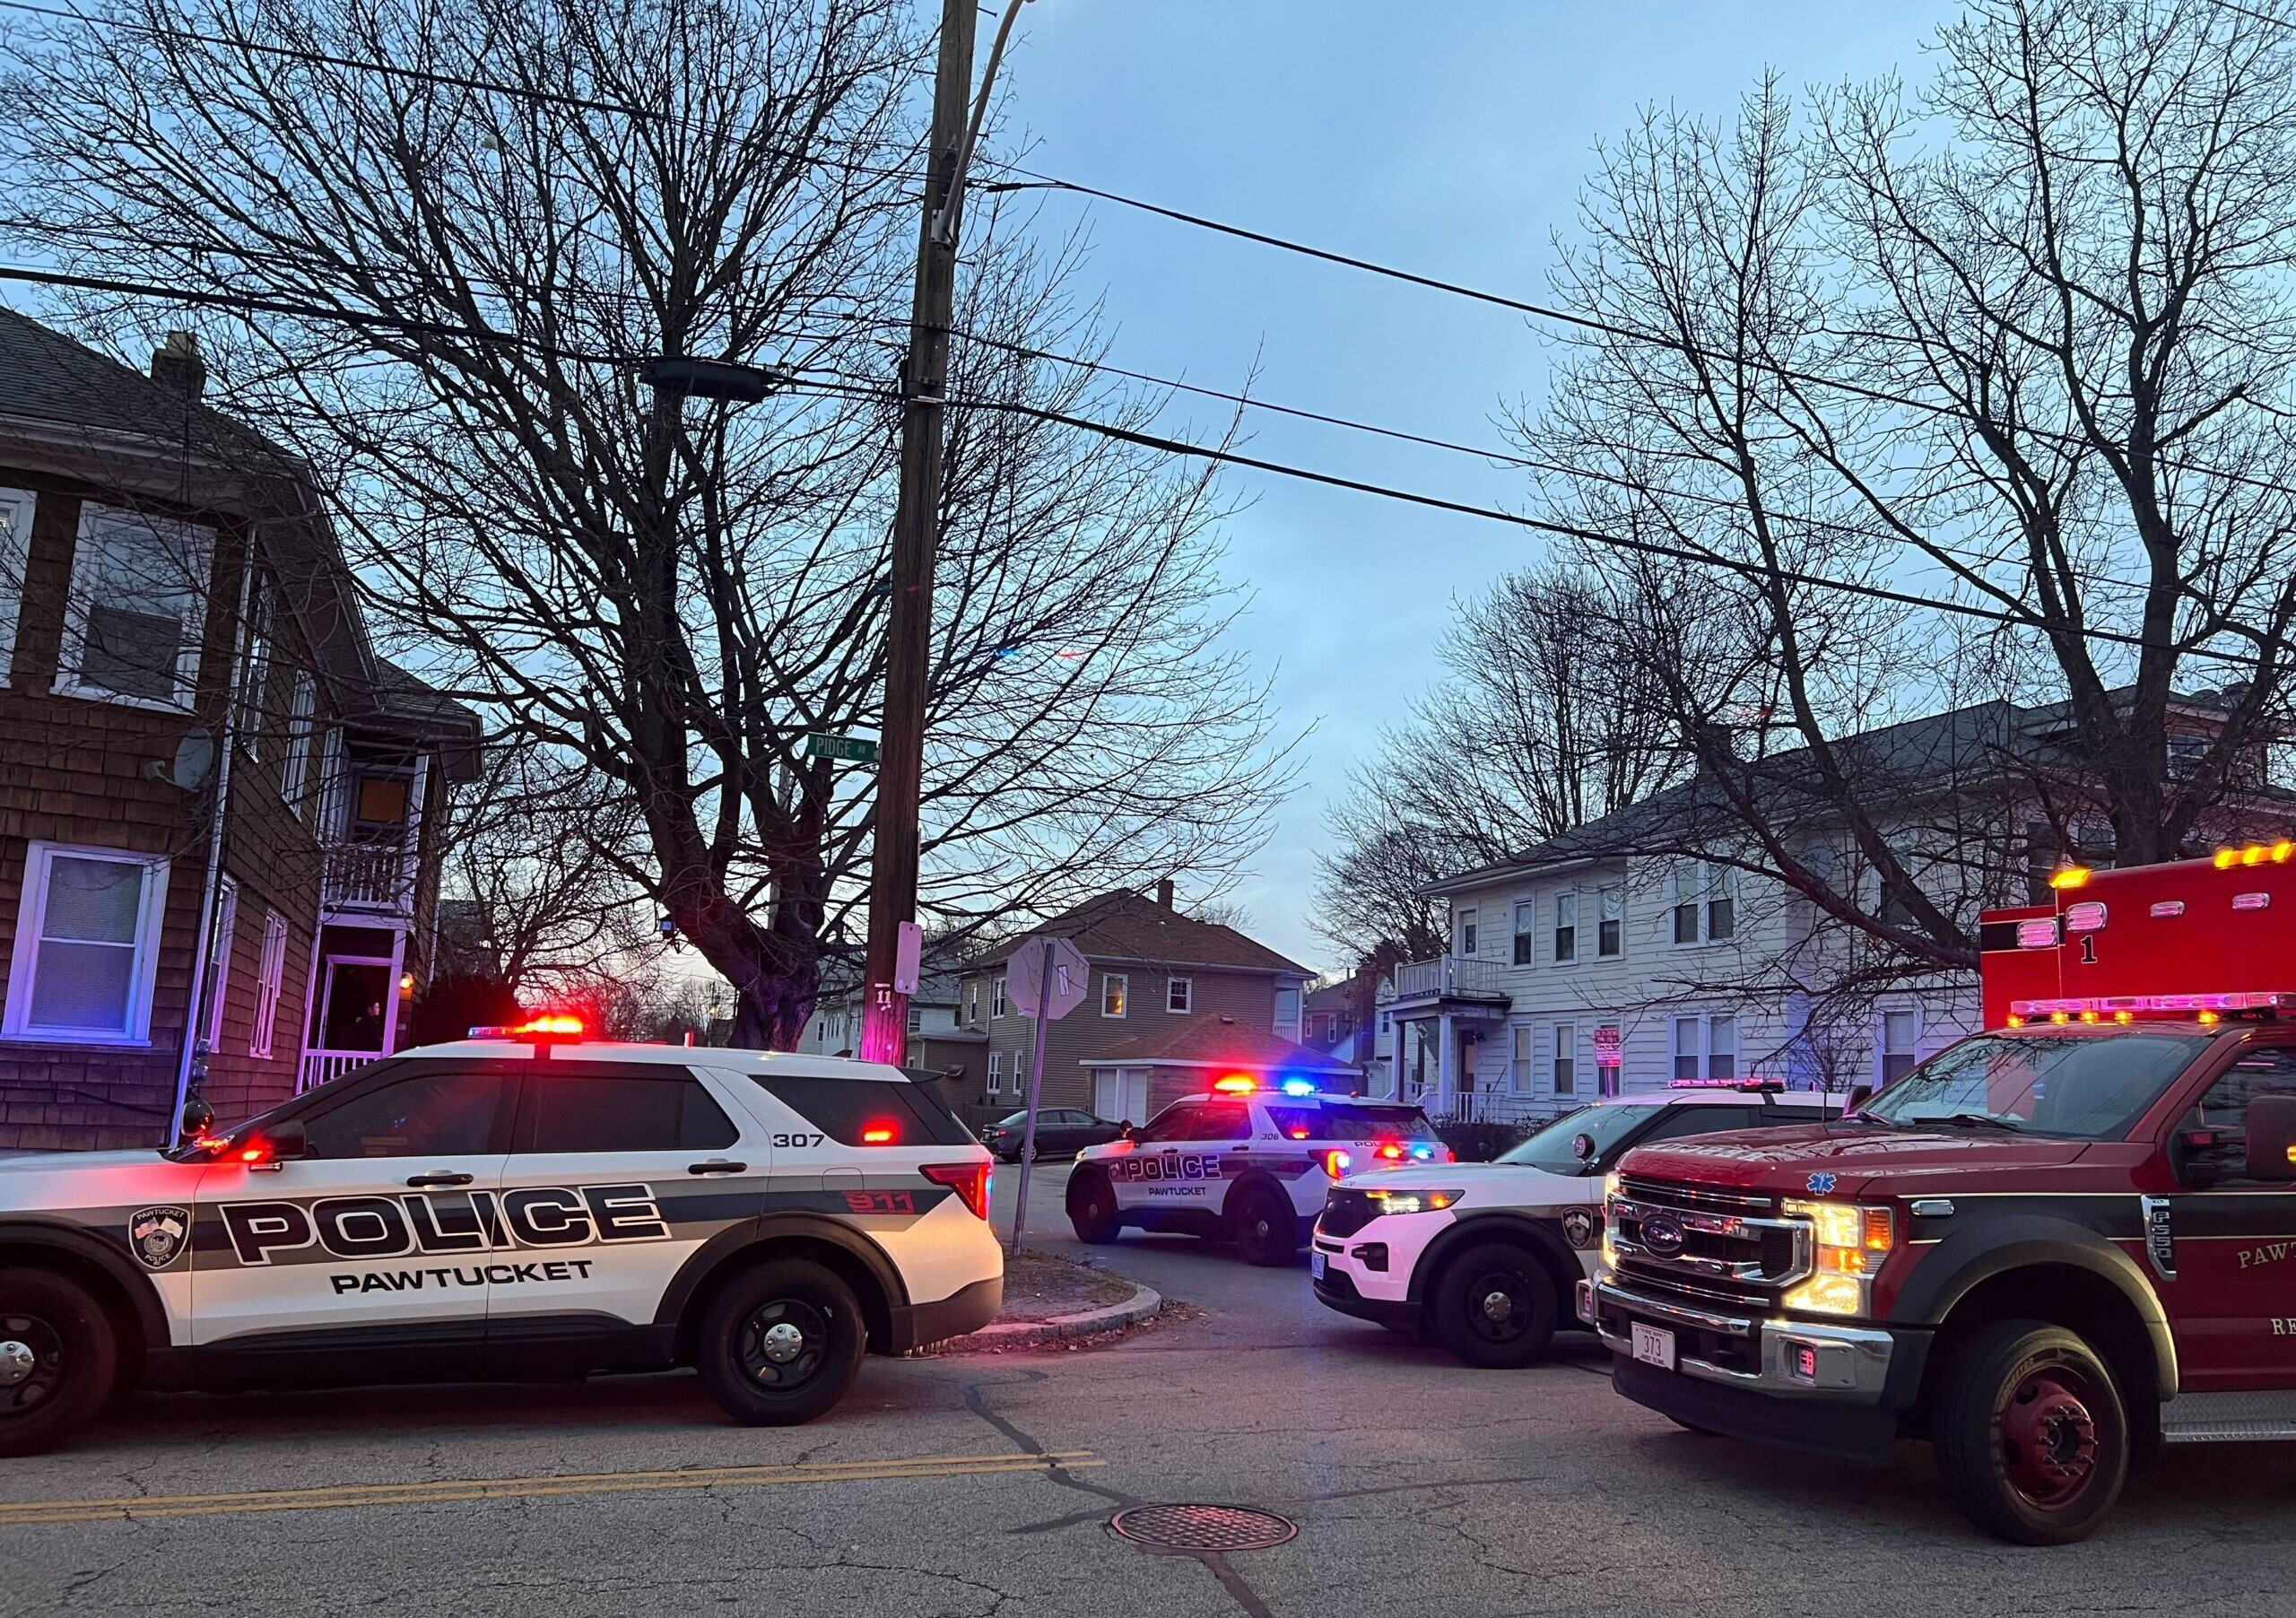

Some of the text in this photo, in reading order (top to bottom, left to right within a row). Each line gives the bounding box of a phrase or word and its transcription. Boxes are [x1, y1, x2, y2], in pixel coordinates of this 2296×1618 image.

[815, 736, 866, 757] PIDGE AV
[2080, 935, 2097, 963] 1
[876, 990, 891, 1004] 11
[773, 1134, 824, 1148] 307
[1261, 1133, 1279, 1141] 306
[1124, 1154, 1222, 1182] POLICE
[846, 1190, 914, 1213] 911
[1148, 1187, 1206, 1196] PAWTUCKET
[136, 1208, 185, 1220] PAWTUCKET
[217, 1182, 673, 1266] POLICE
[144, 1253, 171, 1262] POLICE
[330, 1260, 593, 1295] PAWTUCKET
[1644, 1335, 1661, 1356] 373
